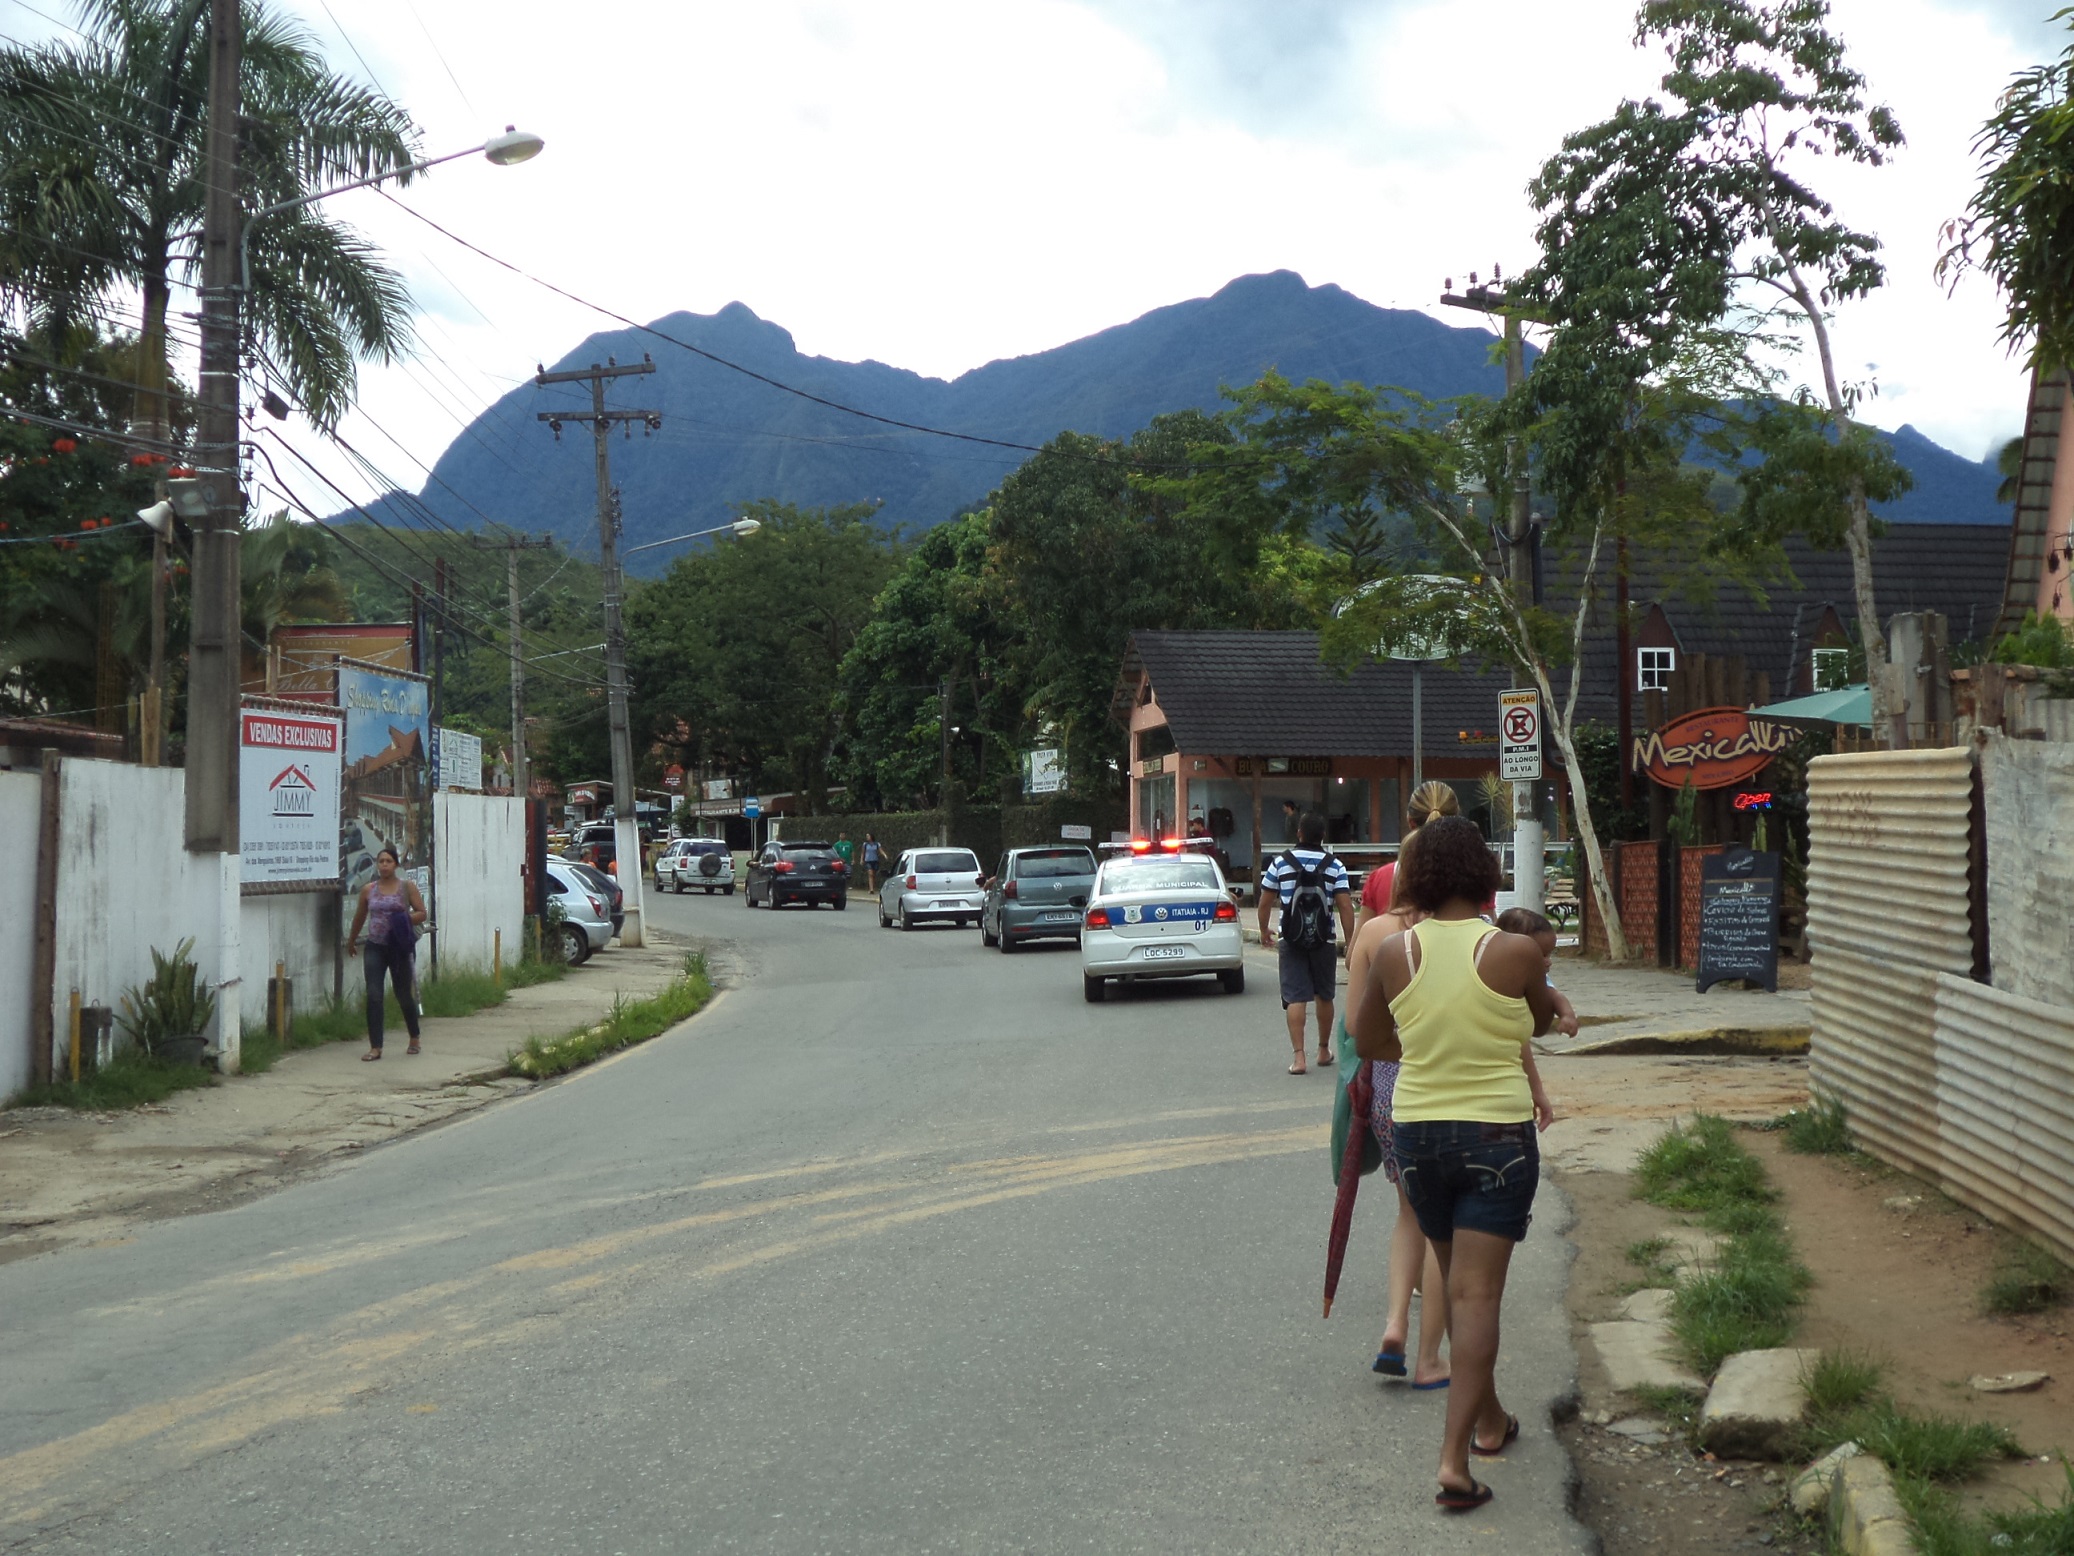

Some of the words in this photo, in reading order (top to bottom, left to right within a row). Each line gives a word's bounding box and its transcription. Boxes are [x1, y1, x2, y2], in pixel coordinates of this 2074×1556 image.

[1503, 695, 1535, 705] ATENÇÃO
[1686, 715, 1739, 733] RESTAURANTE
[250, 722, 283, 745] VENDAS
[284, 726, 332, 748] EXCLUSIVAS
[1515, 755, 1539, 763] LONGO
[1291, 759, 1329, 774] COURO
[1509, 765, 1519, 773] DA
[274, 790, 311, 812] JIMMY
[1734, 793, 1771, 809] Open
[1110, 883, 1153, 893] GUARDA
[1156, 880, 1208, 889] MUNICIPAL
[1171, 908, 1196, 917] ITATIAIA
[1201, 907, 1209, 916] RJ
[1194, 920, 1207, 931] 01
